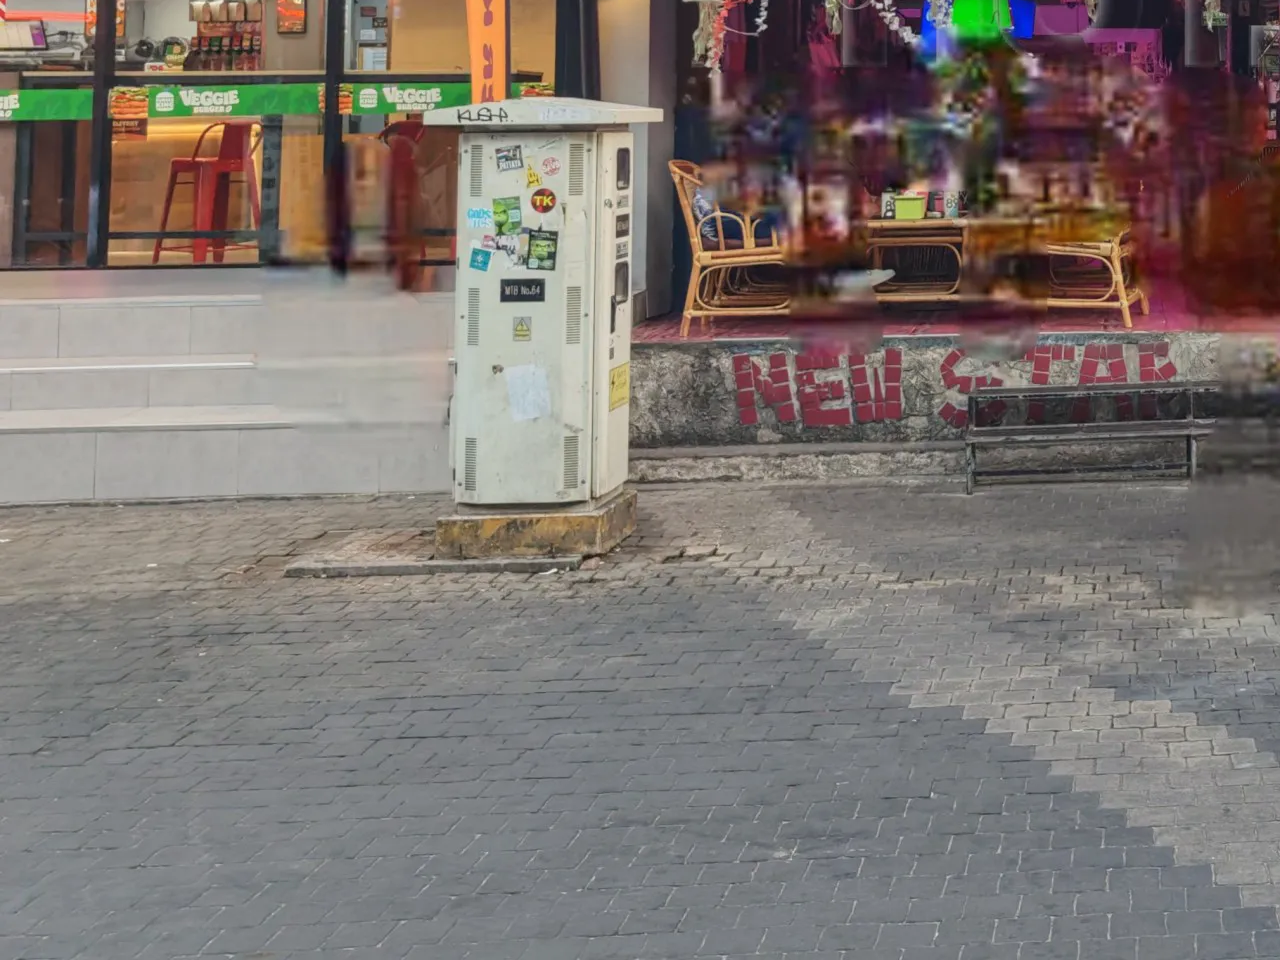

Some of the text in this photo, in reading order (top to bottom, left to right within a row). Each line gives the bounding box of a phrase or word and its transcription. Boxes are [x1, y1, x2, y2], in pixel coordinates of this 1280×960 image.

[179, 90, 240, 107] VEGGIE
[382, 87, 442, 104] VEGGIE
[533, 195, 553, 207] TK
[505, 284, 540, 296] MTB No.64
[732, 346, 903, 428] NEW
